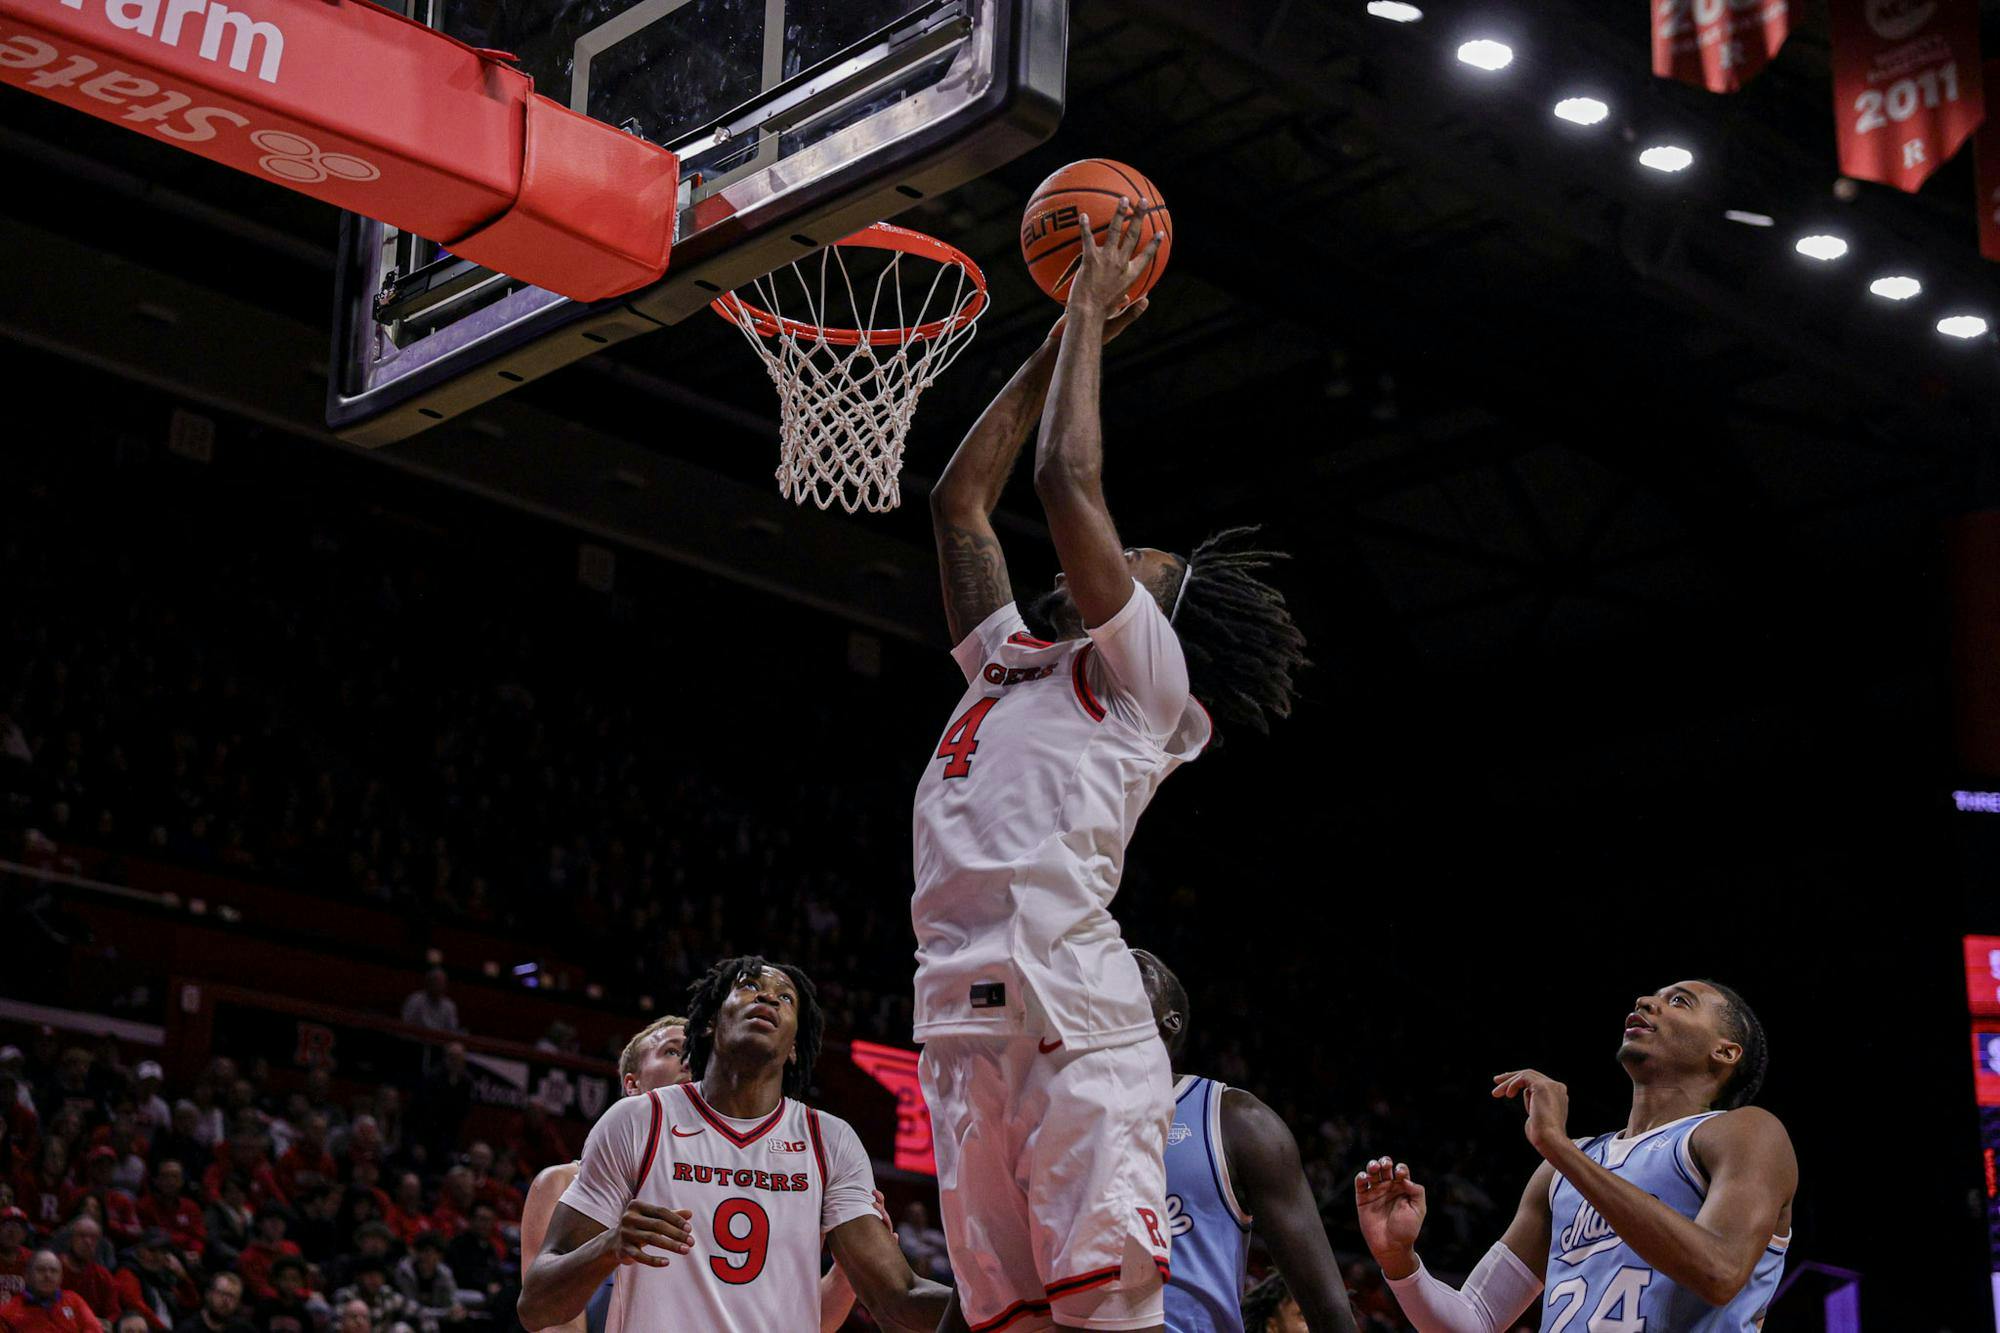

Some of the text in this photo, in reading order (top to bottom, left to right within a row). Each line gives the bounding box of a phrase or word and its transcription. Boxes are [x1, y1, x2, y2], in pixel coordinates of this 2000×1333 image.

[59, 0, 284, 84] arm
[0, 34, 250, 142] State
[1854, 60, 1959, 134] 2011
[1902, 137, 1927, 170] R
[936, 696, 1000, 780] 4
[673, 1162, 809, 1192] RUTGERS
[709, 1197, 770, 1285] 9
[1135, 1207, 1168, 1249] R
[1547, 1265, 1653, 1333] 24
